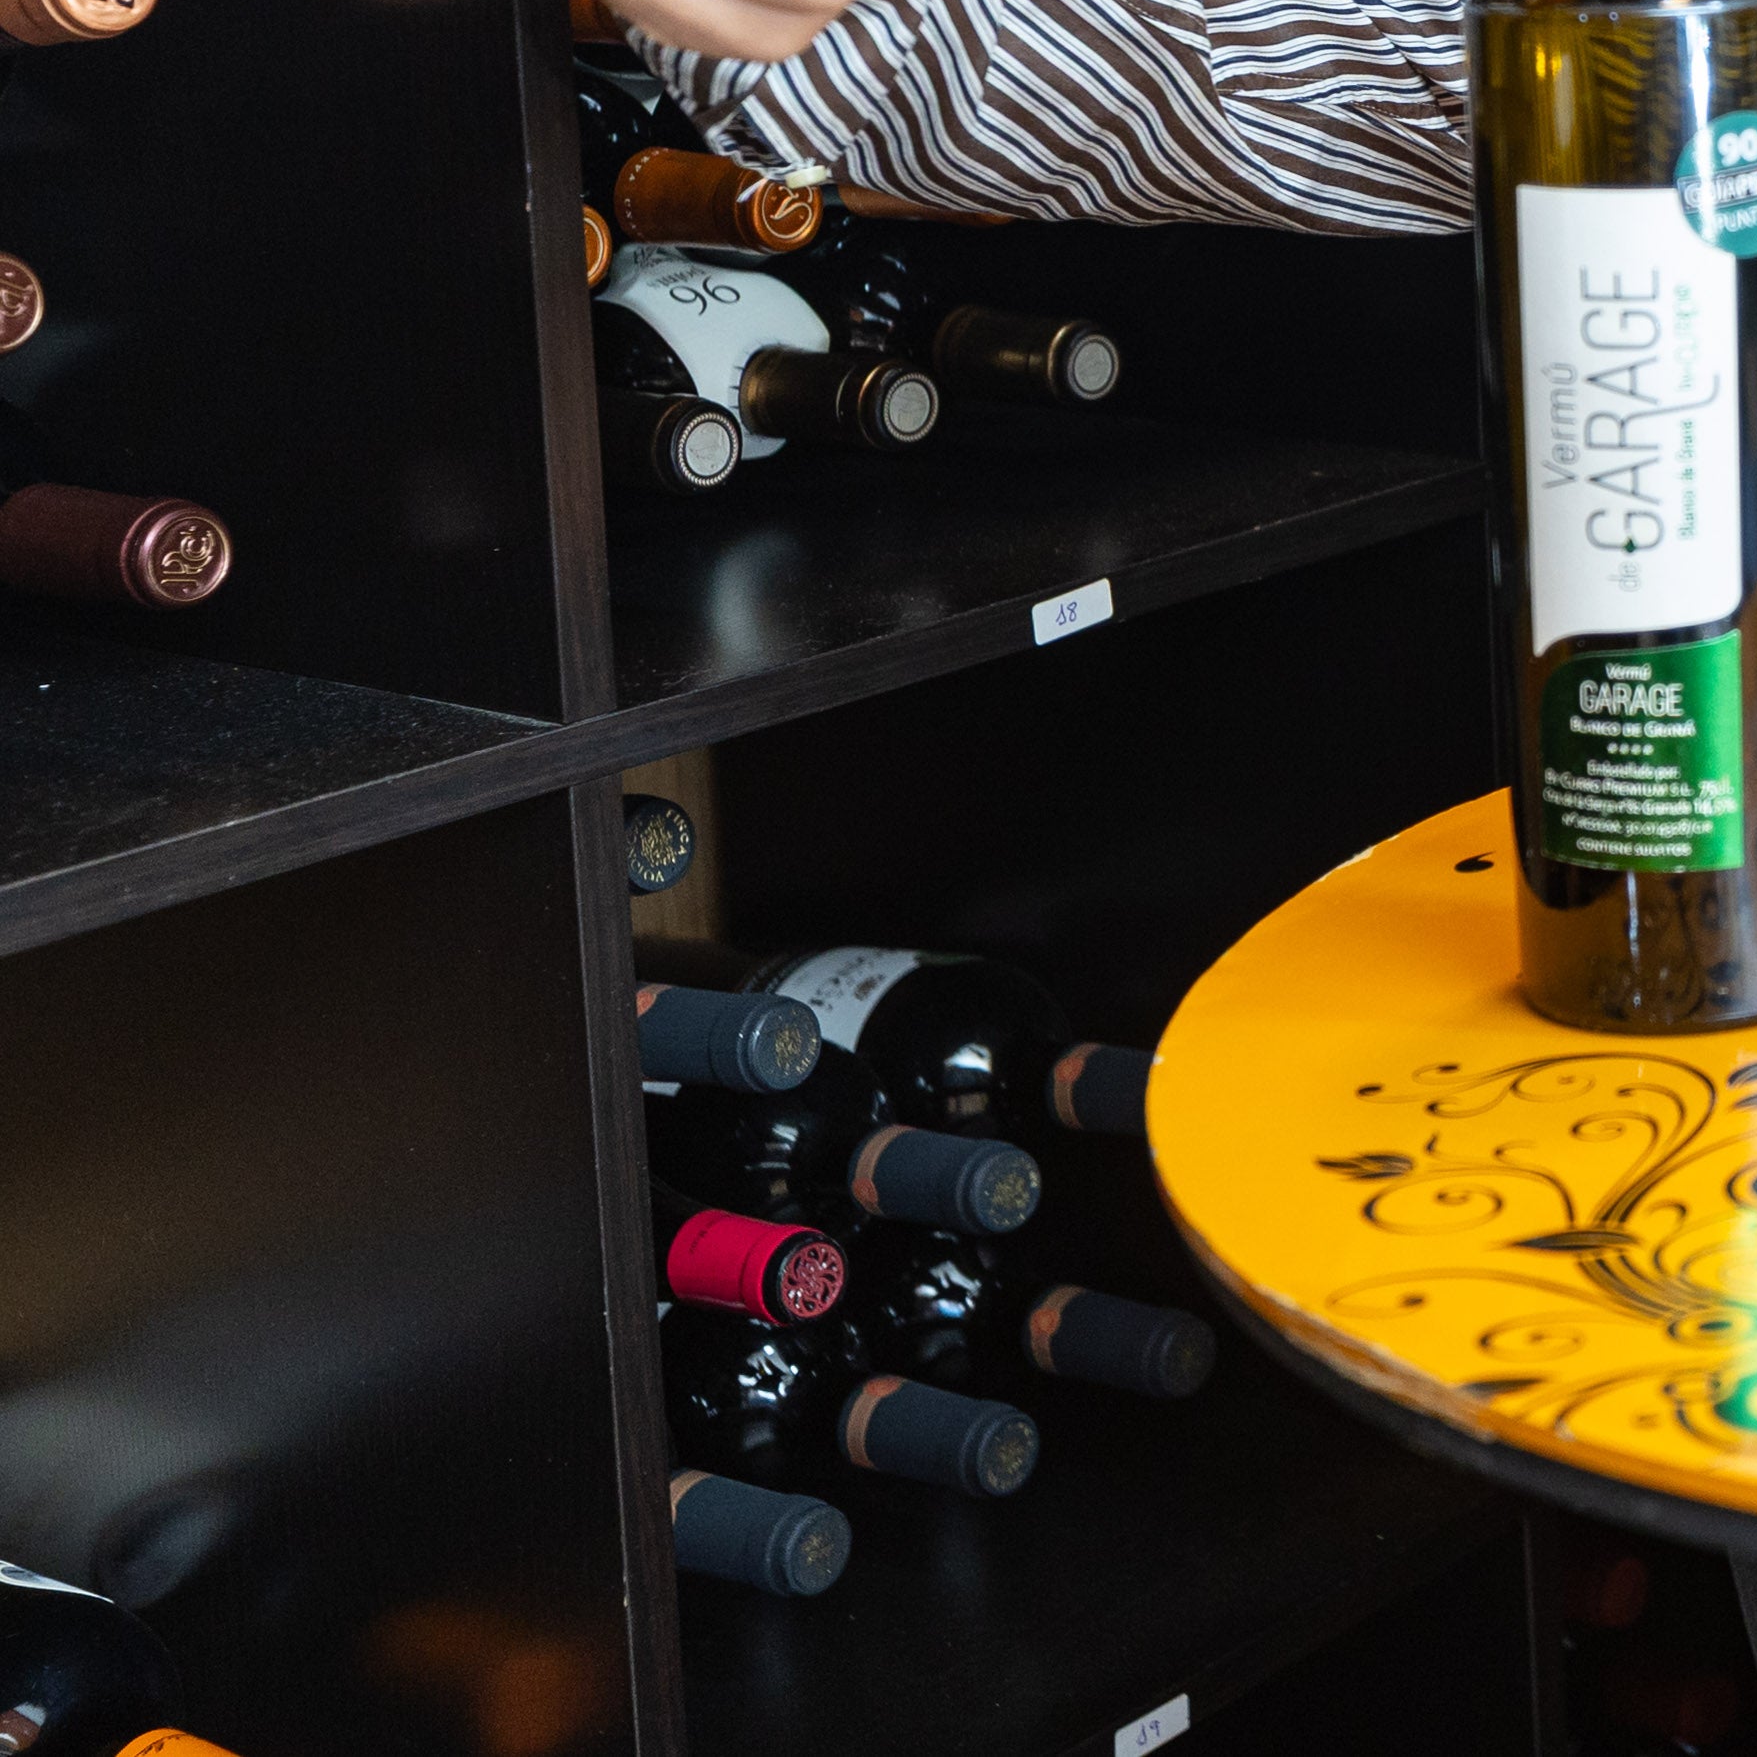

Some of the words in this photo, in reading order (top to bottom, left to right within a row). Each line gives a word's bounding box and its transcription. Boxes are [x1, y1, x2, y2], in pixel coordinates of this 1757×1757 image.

[669, 275, 741, 315] 96
[1541, 361, 1578, 490] Vermú
[1580, 266, 1720, 554] GARAGE
[1606, 561, 1642, 593] de
[1056, 601, 1078, 626] 18
[1604, 662, 1652, 681] Vermú
[1579, 679, 1684, 717] GARAGE
[665, 808, 690, 858] FINCA
[1576, 836, 1633, 856] CONTIENE
[1633, 841, 1693, 857] SULFITOS
